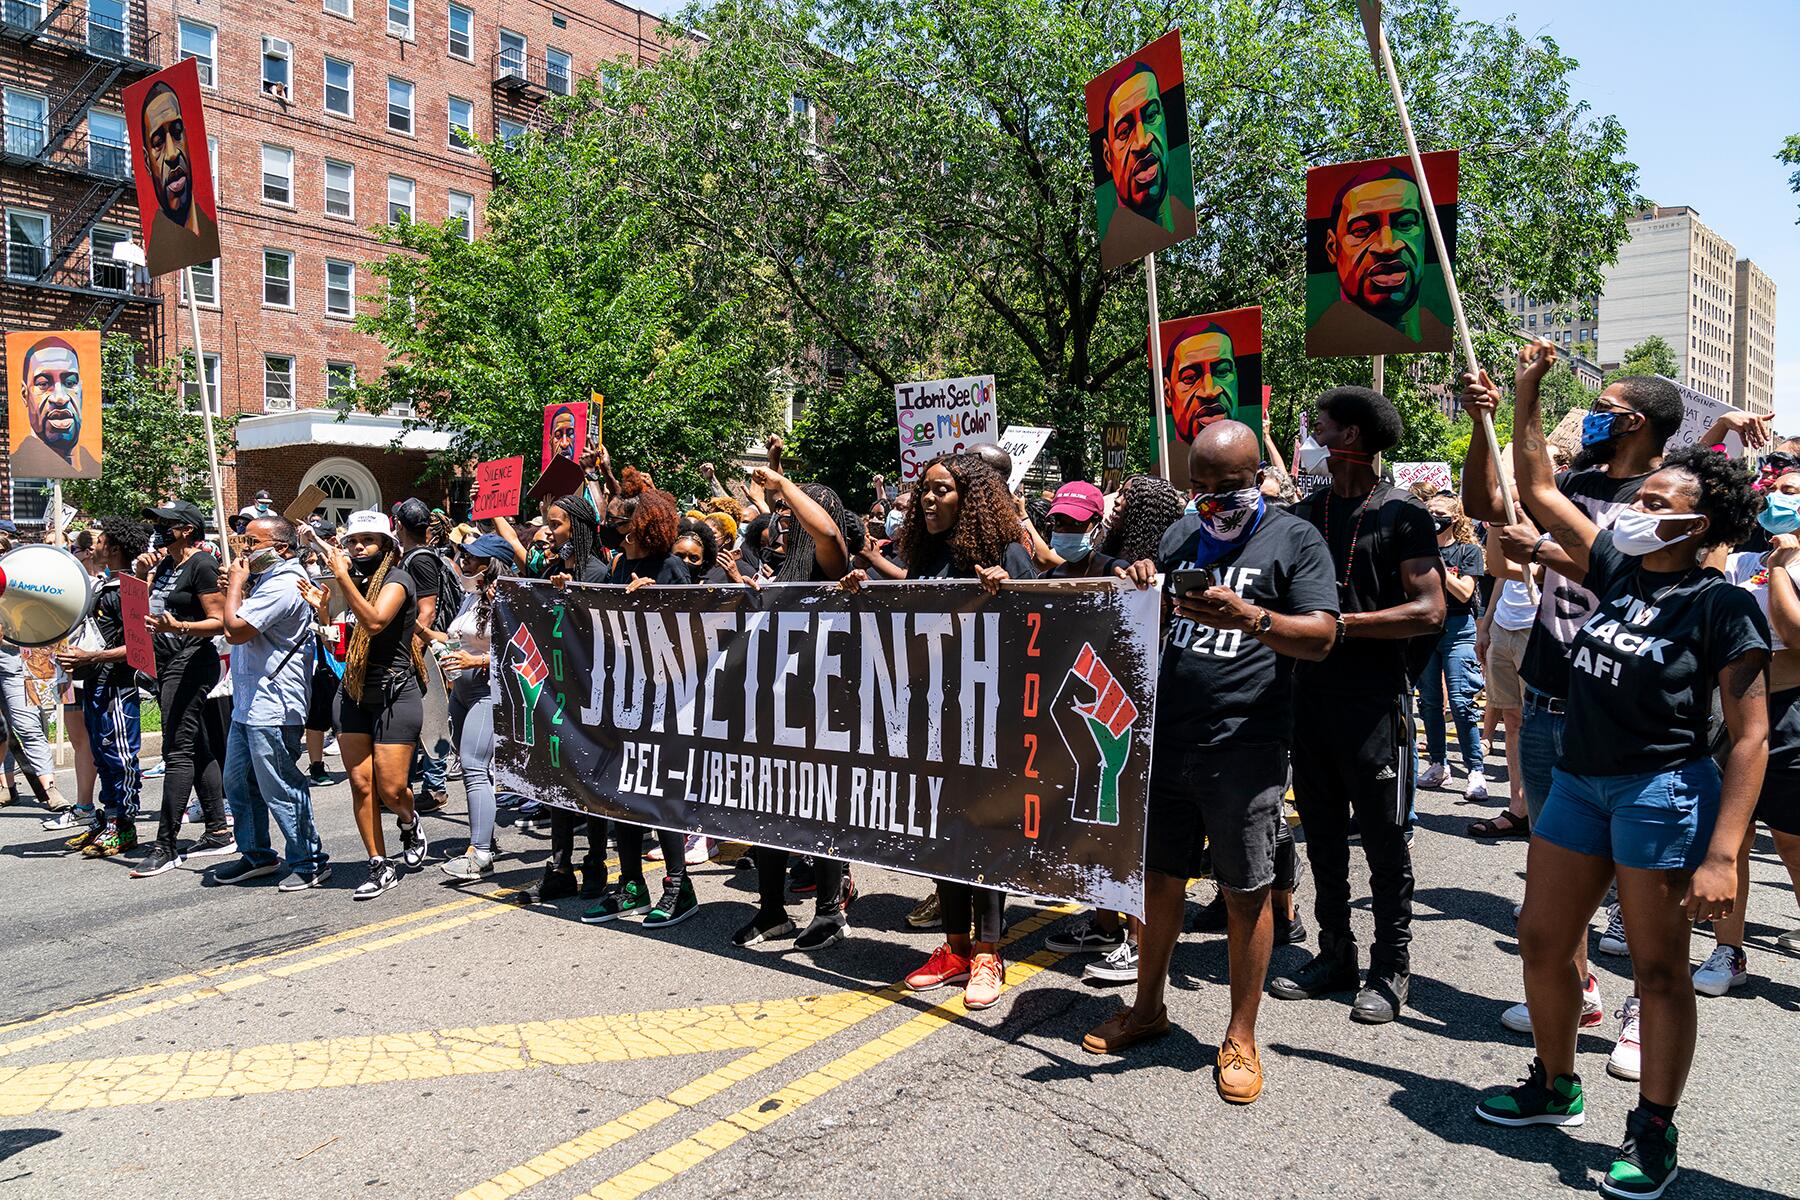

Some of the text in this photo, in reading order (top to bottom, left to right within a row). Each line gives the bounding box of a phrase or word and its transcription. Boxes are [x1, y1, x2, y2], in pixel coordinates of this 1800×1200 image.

[899, 387, 914, 410] I
[946, 384, 970, 410] See
[970, 380, 994, 408] Color
[1678, 387, 1717, 409] MAGINE
[1683, 405, 1699, 421] HAT
[898, 409, 935, 443] See
[961, 409, 991, 435] Color
[484, 465, 512, 482] SILENCE
[1398, 468, 1412, 480] NO
[1582, 612, 1674, 664] LACK
[1573, 646, 1622, 687] AF!
[550, 605, 567, 769] 2020
[580, 607, 1000, 769] JUNETEENTH
[1023, 612, 1041, 839] 2020
[617, 740, 944, 839] CEL-LIBERATION RALLY
